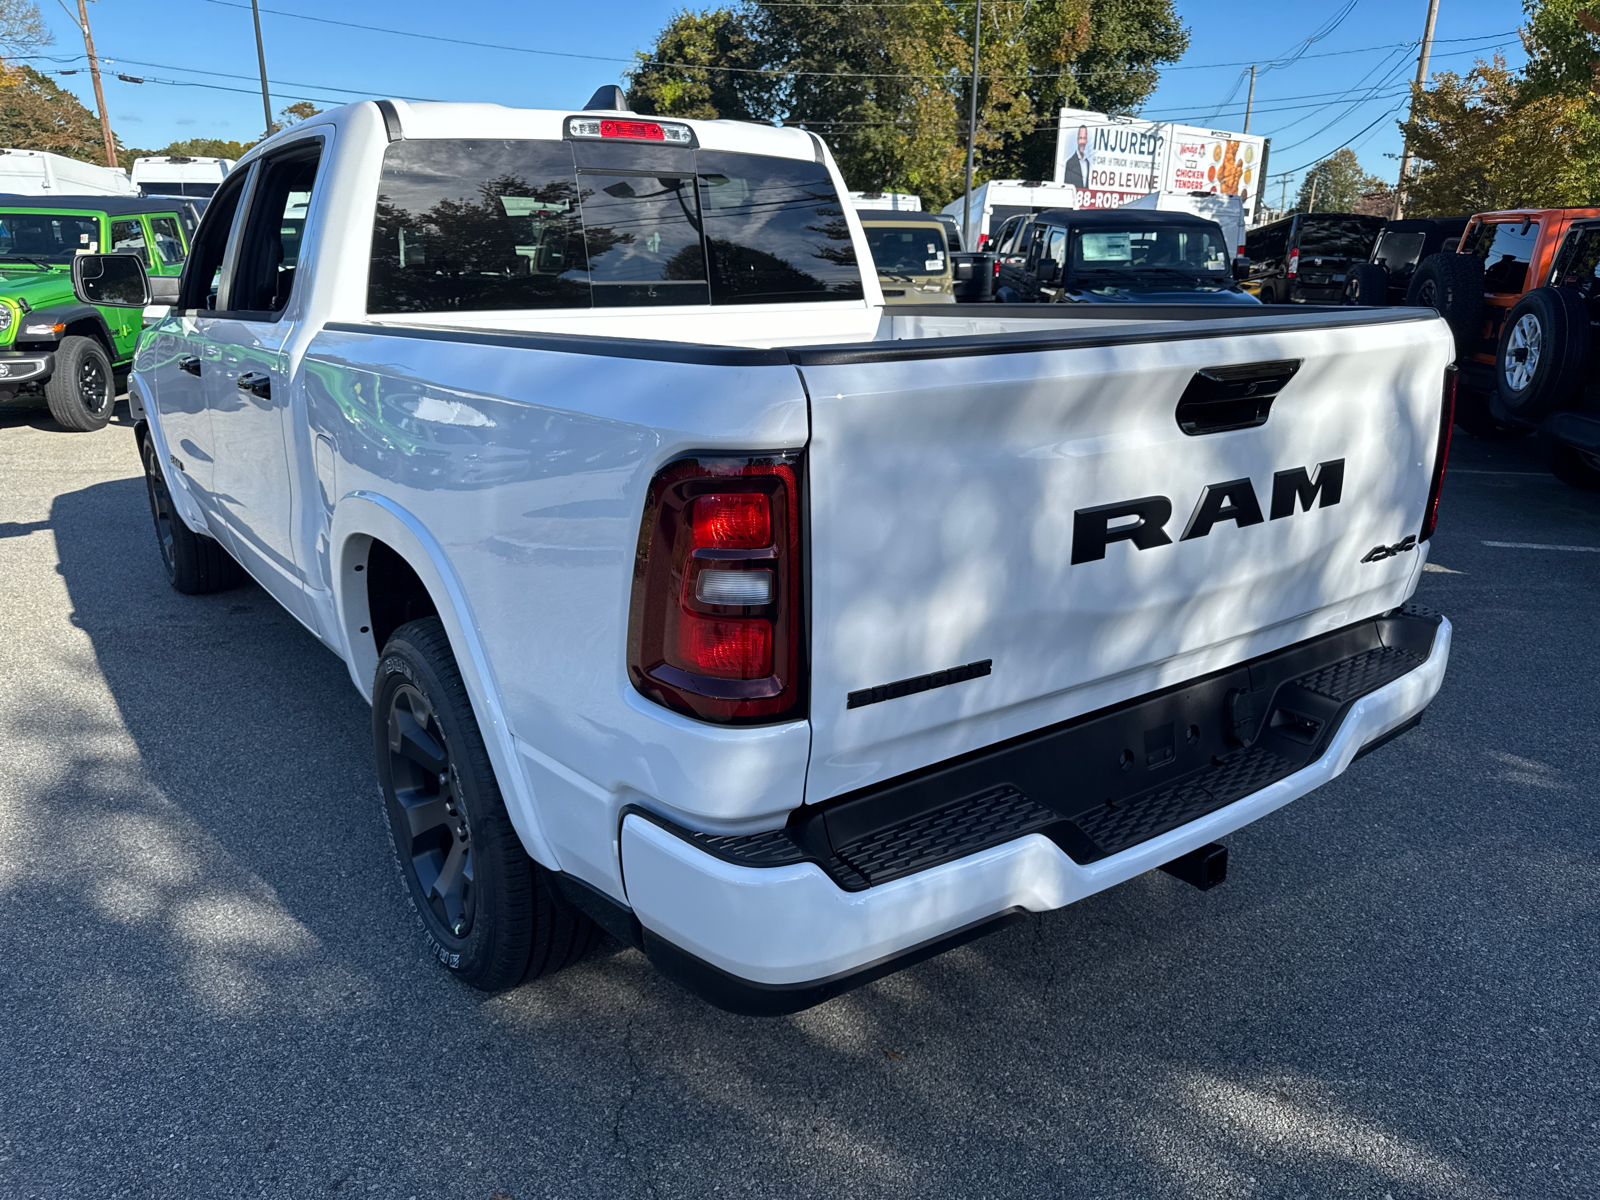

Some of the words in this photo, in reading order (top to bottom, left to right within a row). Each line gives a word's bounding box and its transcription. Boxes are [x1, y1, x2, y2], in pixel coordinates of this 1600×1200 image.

[1093, 128, 1164, 157] INJURED?
[1091, 169, 1116, 187] ROB
[1118, 172, 1159, 189] LEVINE
[1175, 168, 1205, 180] CHICKEN
[1175, 179, 1203, 190] TENDERS
[1071, 457, 1345, 565] RAM
